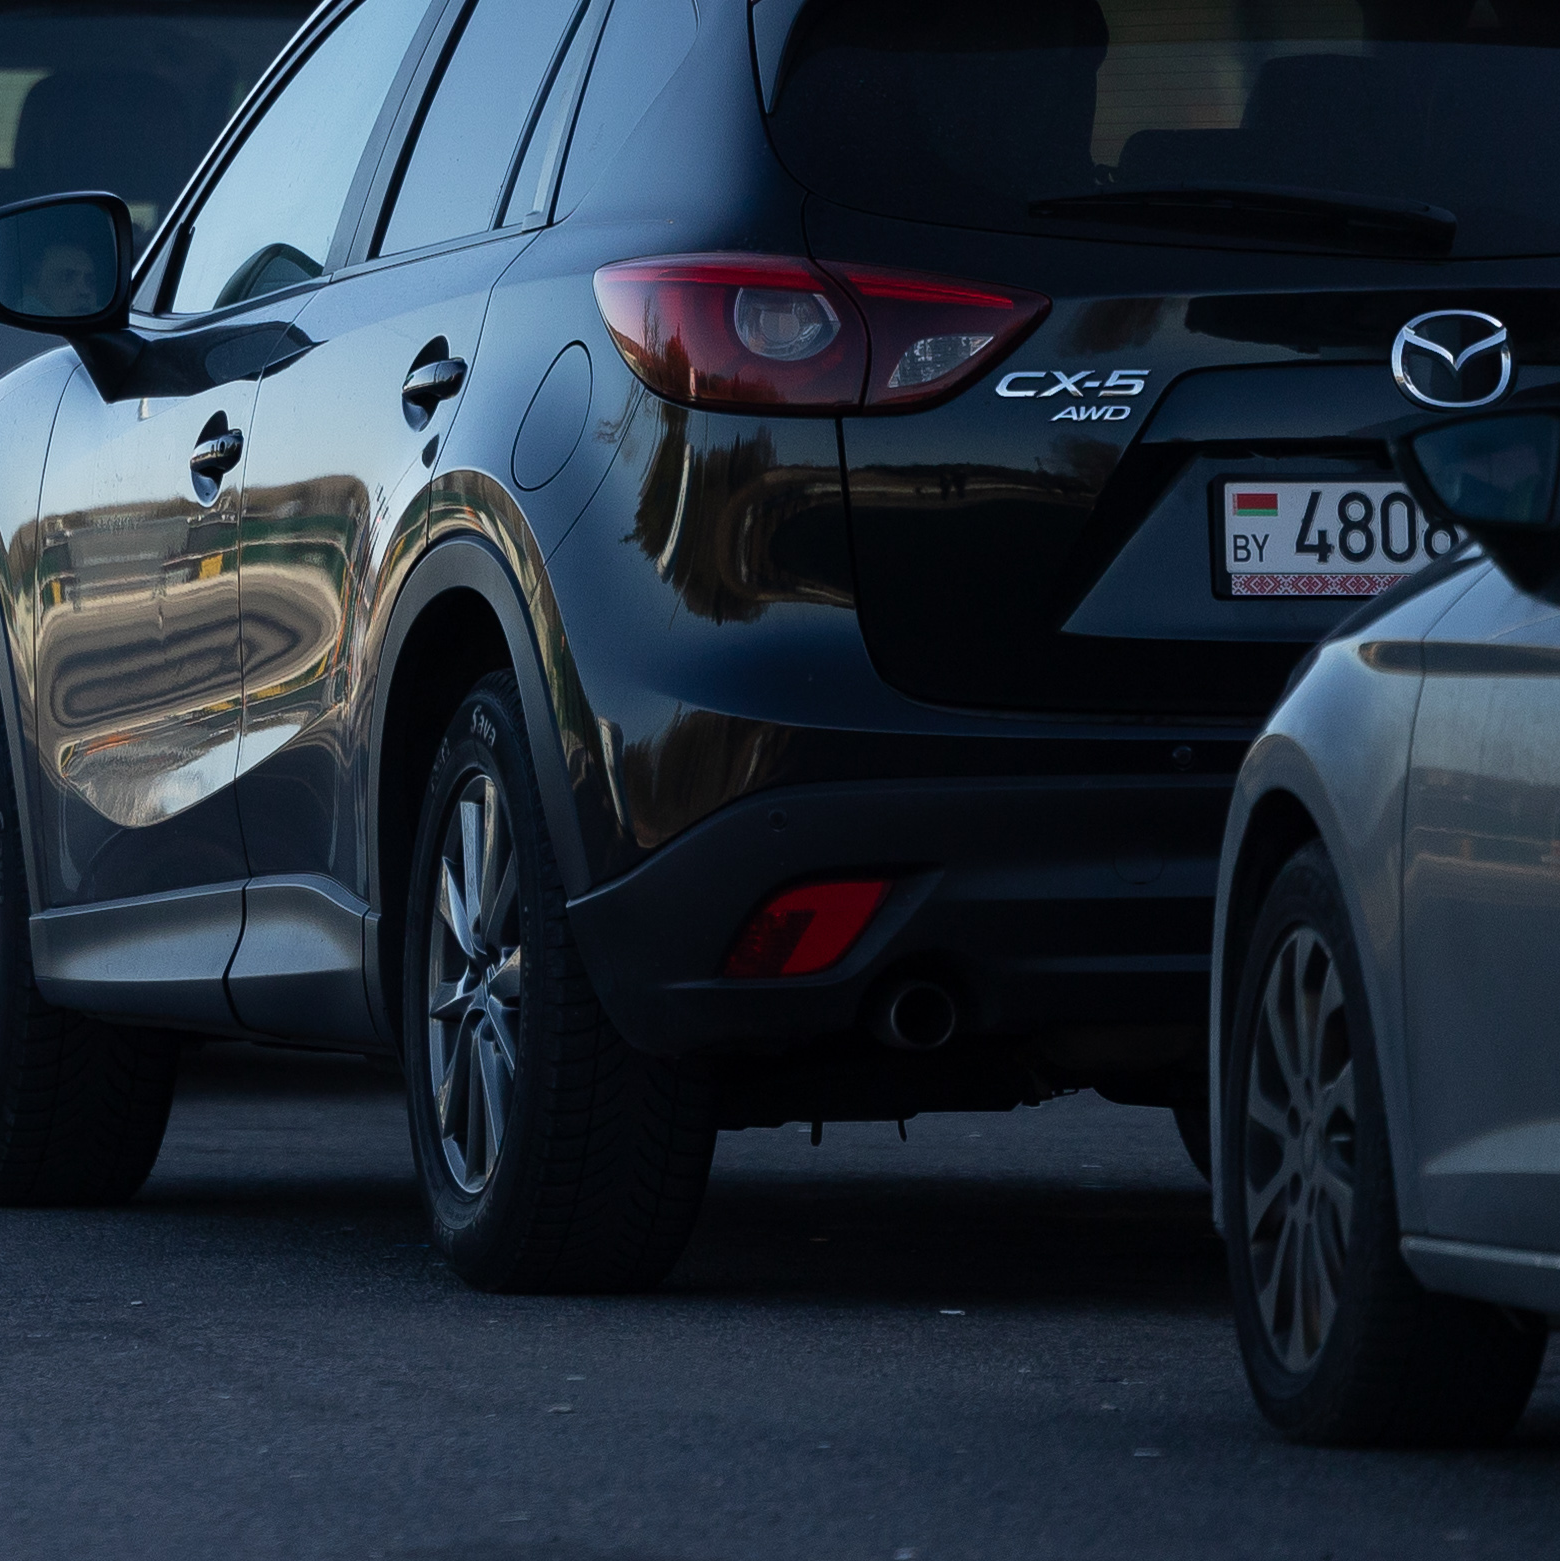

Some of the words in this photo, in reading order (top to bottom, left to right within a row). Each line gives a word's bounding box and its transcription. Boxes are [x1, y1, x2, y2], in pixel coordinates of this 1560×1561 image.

[995, 369, 1152, 399] CX-5
[1049, 405, 1131, 422] AWD
[1232, 533, 1270, 563] BY
[469, 704, 497, 748] Sava
